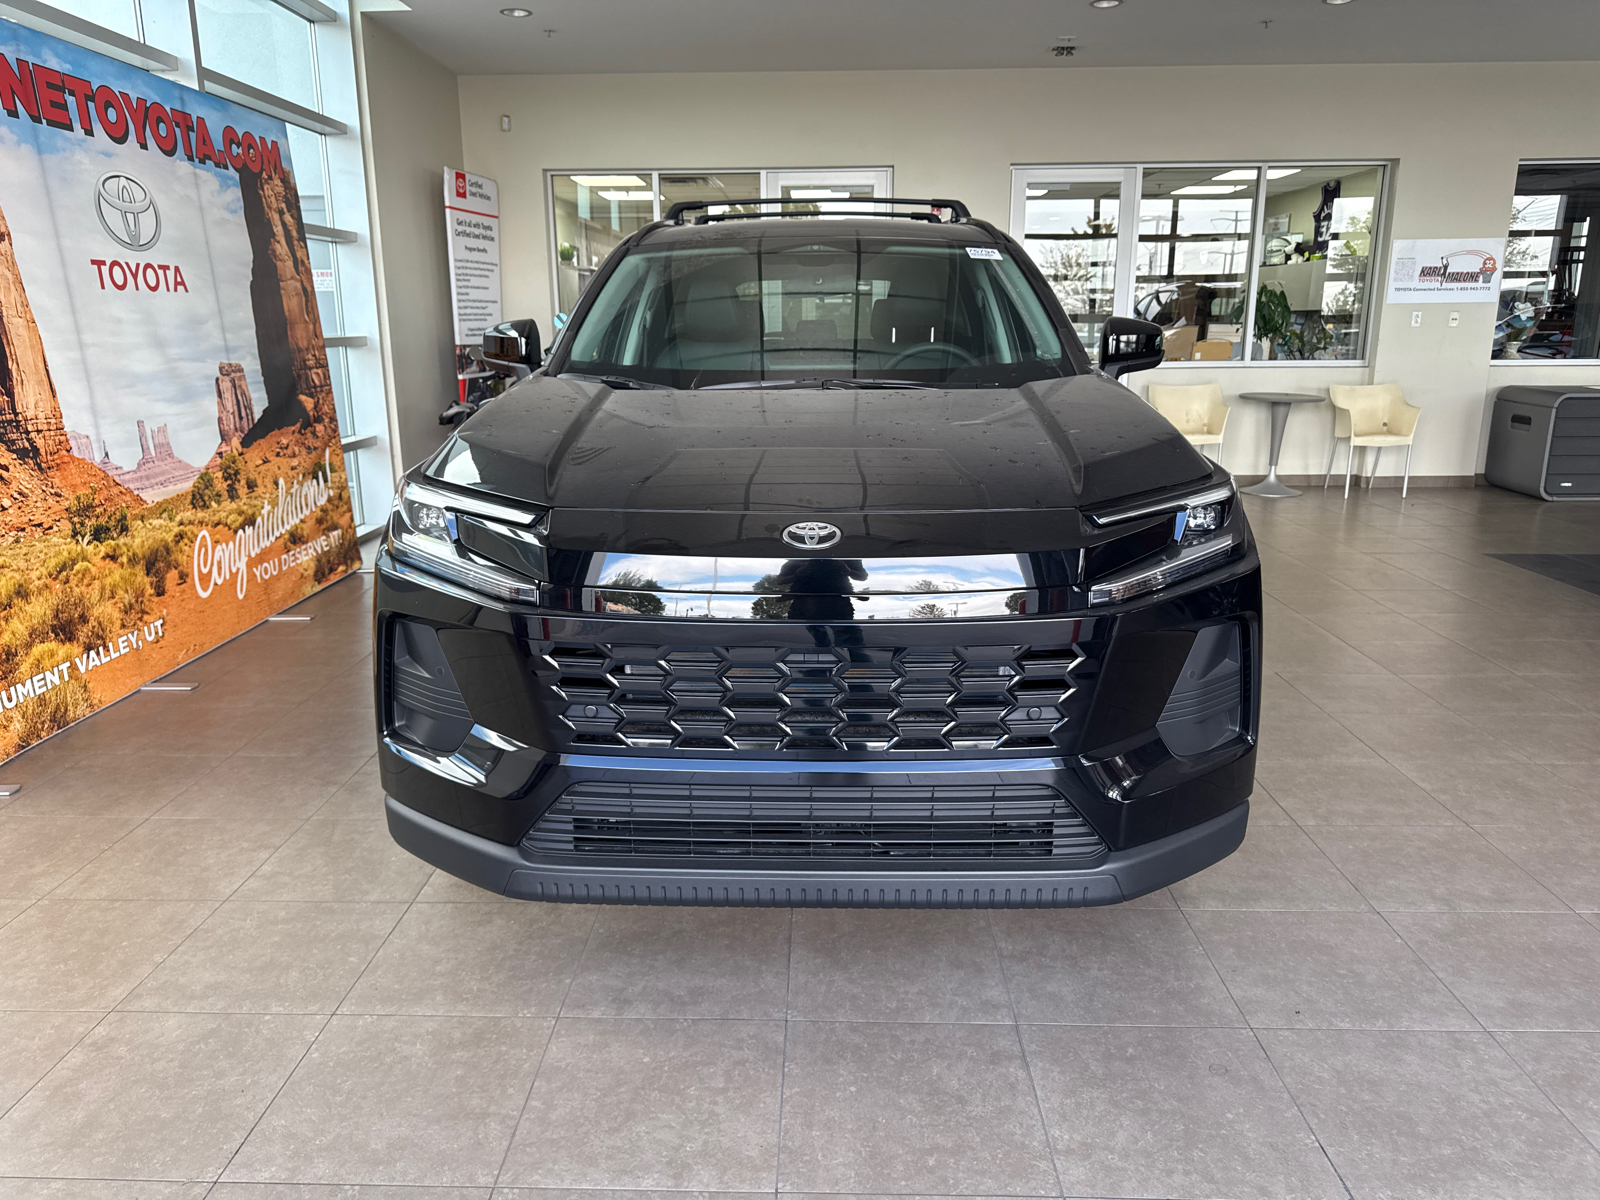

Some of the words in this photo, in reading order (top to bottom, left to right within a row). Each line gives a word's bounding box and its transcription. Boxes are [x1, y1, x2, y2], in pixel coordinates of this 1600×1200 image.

[0, 52, 285, 180] NETOYOTA.COM
[468, 179, 483, 190] Certified
[468, 189, 478, 198] Used
[478, 191, 491, 202] Vehicles
[456, 217, 464, 227] Get
[473, 221, 481, 230] with
[481, 222, 493, 232] Toyota
[455, 228, 471, 239] Certified
[471, 231, 481, 240] Used
[481, 232, 495, 242] Vehicles
[90, 259, 189, 293] TOYOTA
[1419, 266, 1443, 278] KARL
[1445, 271, 1481, 283] MALONE
[193, 447, 334, 600] Congratulations!
[253, 558, 279, 583] YOU
[281, 536, 330, 571] DESERVE
[330, 528, 343, 547] IT!
[0, 661, 71, 713] UMENT
[74, 630, 143, 674] VALLEY,
[144, 618, 164, 642] UT
